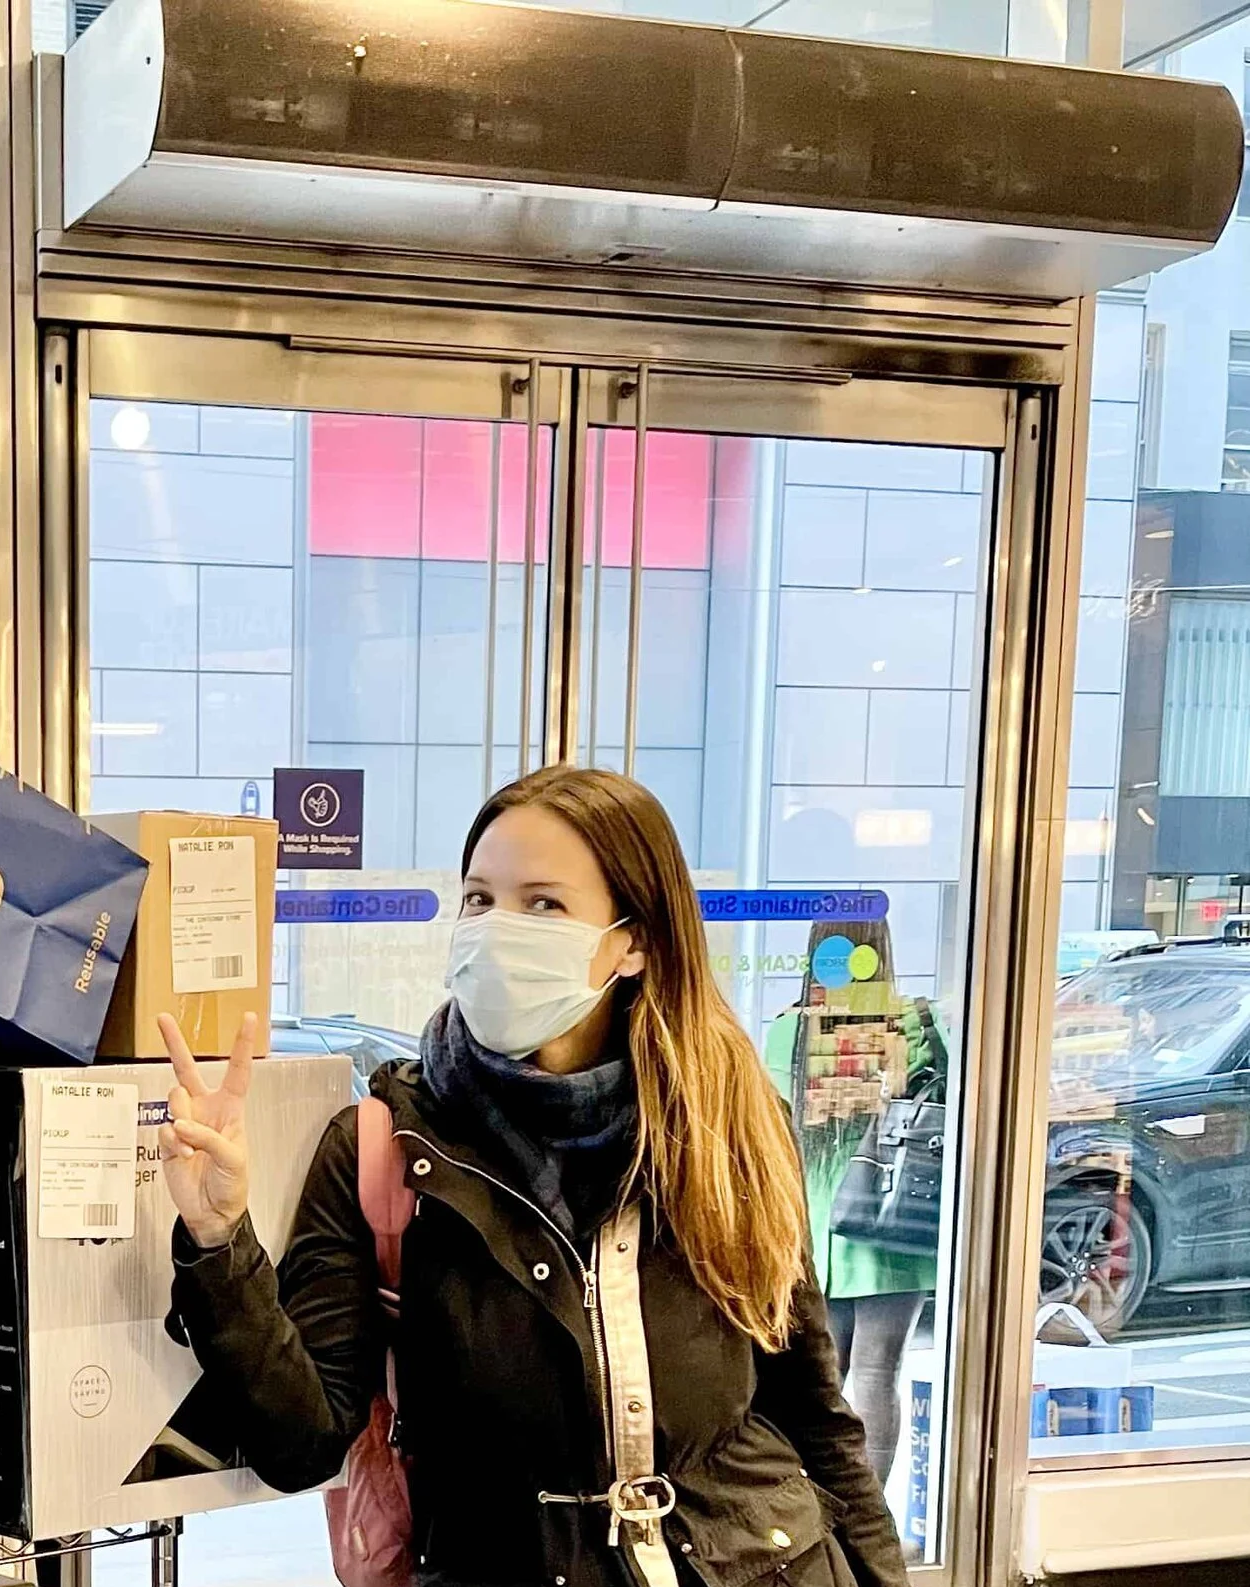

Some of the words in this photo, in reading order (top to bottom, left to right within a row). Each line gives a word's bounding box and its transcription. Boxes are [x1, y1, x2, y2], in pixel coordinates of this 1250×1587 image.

[286, 833, 309, 843] Mask
[320, 834, 359, 844] Required
[178, 842, 213, 852] NATALIE
[218, 841, 234, 850] RON
[283, 844, 308, 853] While
[74, 911, 112, 995] Reusable
[52, 1086, 91, 1098] NATALIE
[97, 1087, 115, 1098] RON
[139, 1105, 168, 1121] iner
[135, 1169, 158, 1188] ger
